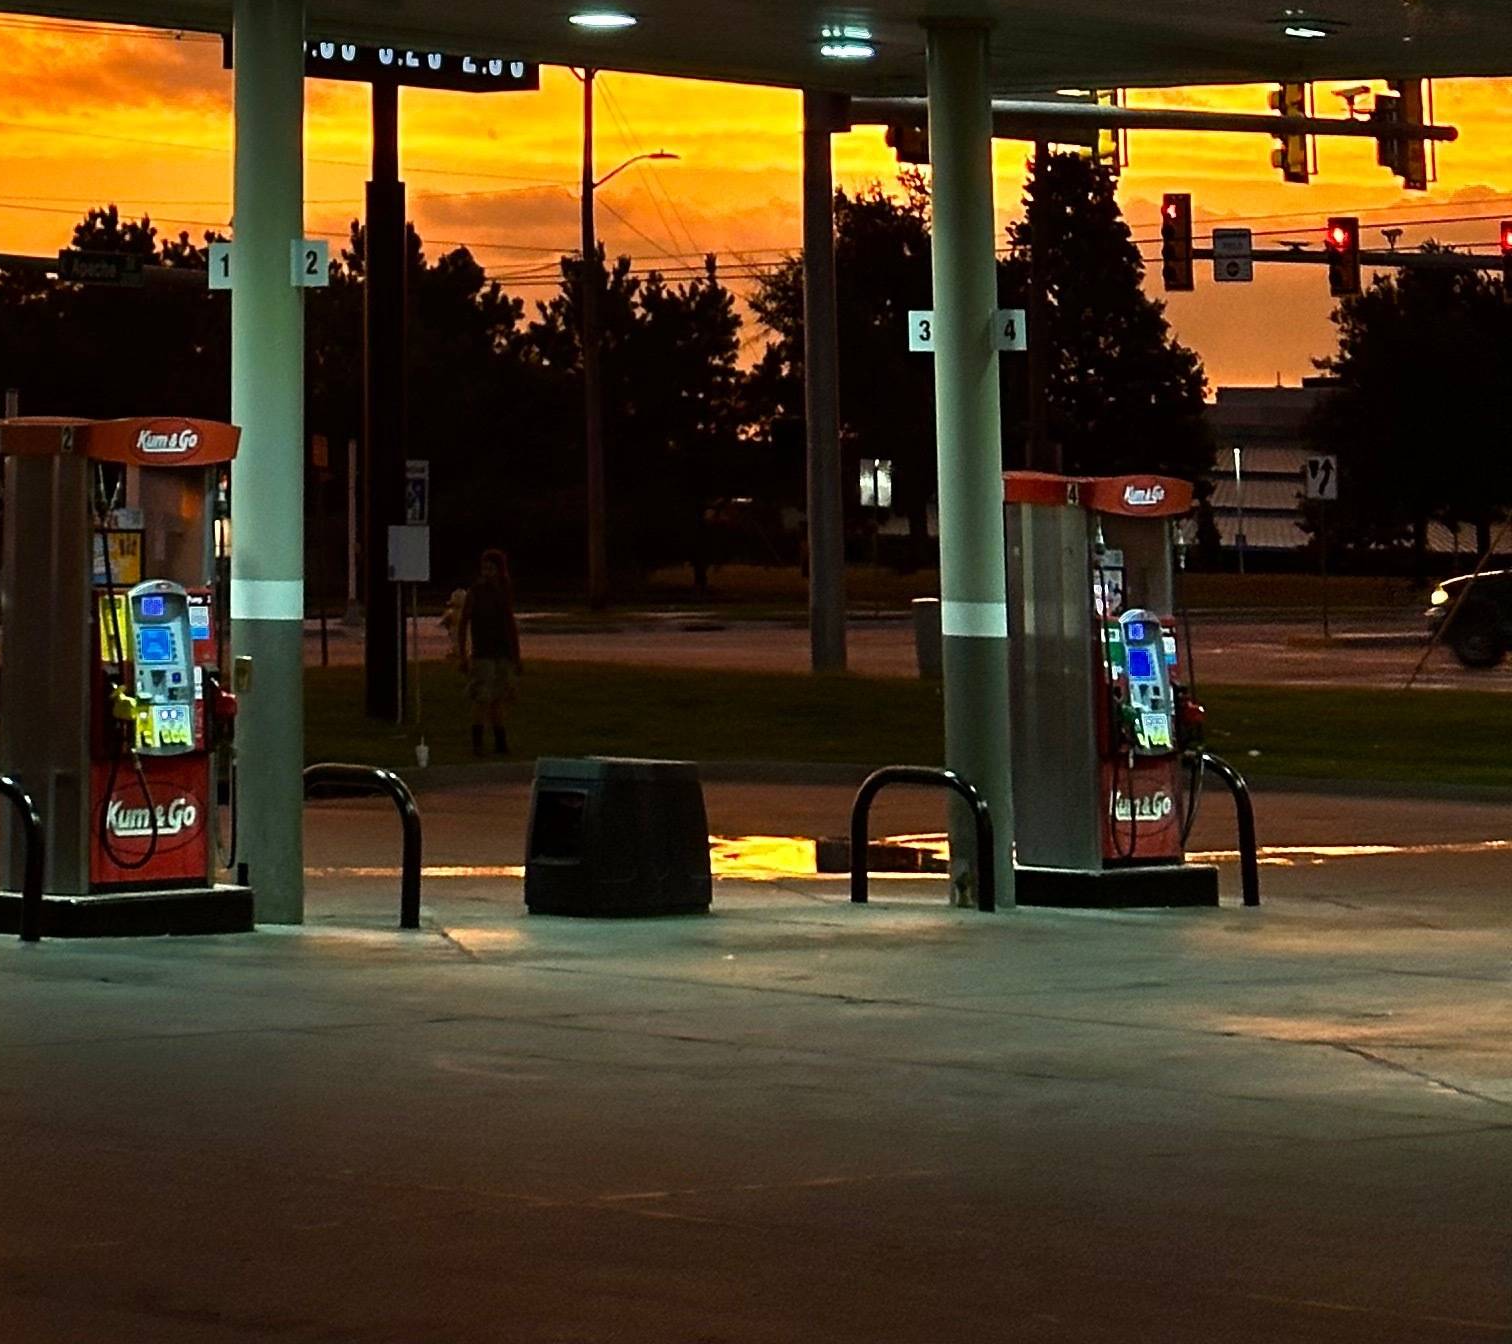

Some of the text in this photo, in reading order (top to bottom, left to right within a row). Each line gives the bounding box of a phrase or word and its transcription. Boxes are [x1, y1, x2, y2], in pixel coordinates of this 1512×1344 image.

[219, 252, 230, 278] 1
[305, 250, 318, 275] 2
[918, 320, 931, 341] 3
[1003, 319, 1017, 341] 4
[63, 427, 72, 450] 2
[1068, 484, 1077, 504] 4
[106, 799, 153, 833] Kum
[168, 797, 197, 831] Go
